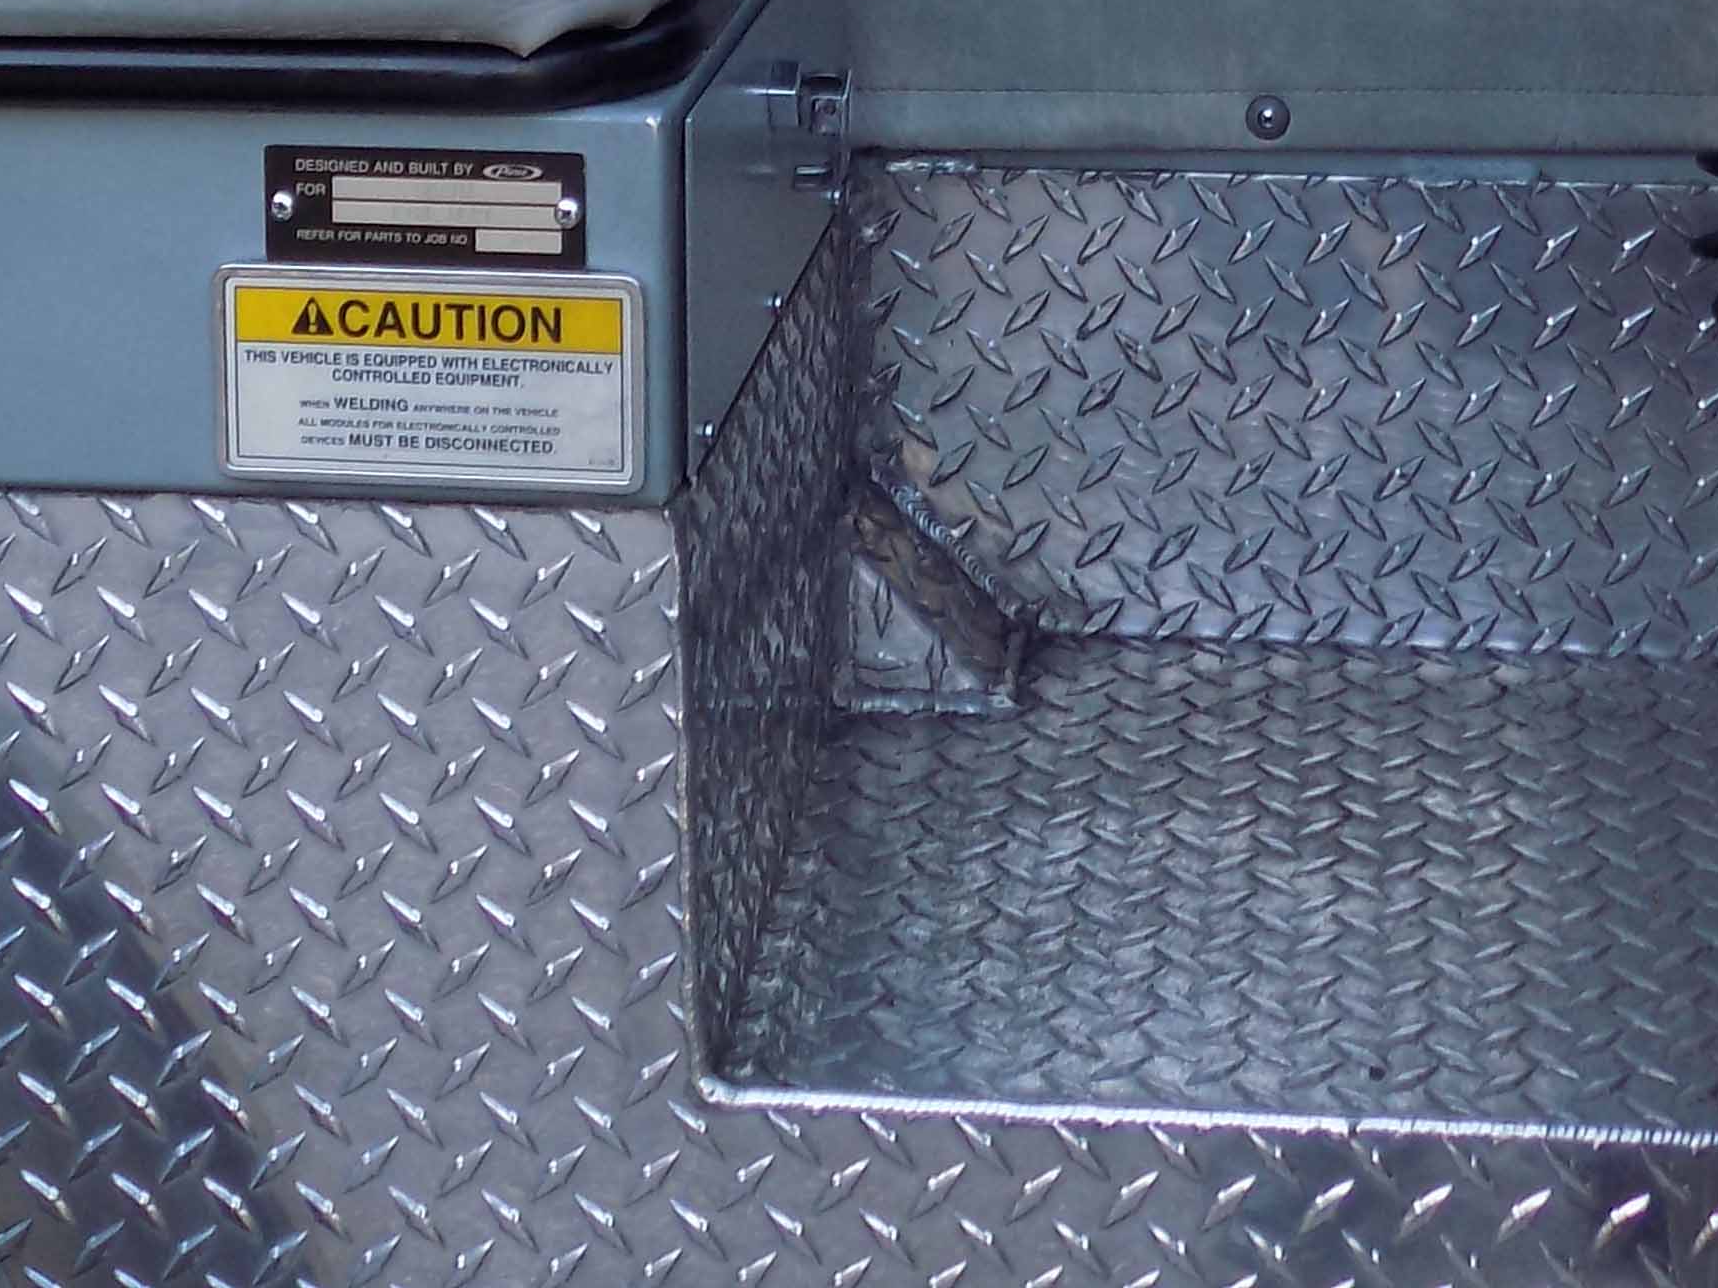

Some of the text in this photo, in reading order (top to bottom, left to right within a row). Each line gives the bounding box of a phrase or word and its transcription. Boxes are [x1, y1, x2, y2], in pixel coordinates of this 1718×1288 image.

[295, 158, 369, 174] DESIGNED
[373, 160, 404, 174] AND
[408, 161, 448, 175] BUILT
[454, 163, 474, 176] BY
[296, 182, 326, 196] FOR
[297, 229, 333, 240] REFER
[338, 230, 362, 241] FOR
[365, 231, 401, 243] PARTS
[406, 232, 421, 243] TO
[424, 233, 447, 245] JOB
[338, 299, 562, 343] CAUTION
[245, 350, 613, 374] THIS VEHICLE IS EQUIPPED WITH ELECTRONICALLY
[332, 368, 431, 384] CONTROLLED
[299, 397, 559, 418] WHEN WELDING ANYWHERE ON THE VEHICLE
[298, 418, 561, 436] ALL MODULES FOR ELECTRONICALLY CONTROLLED
[300, 435, 345, 446] DEVICES
[349, 433, 394, 447] MUST
[398, 435, 420, 449] BE
